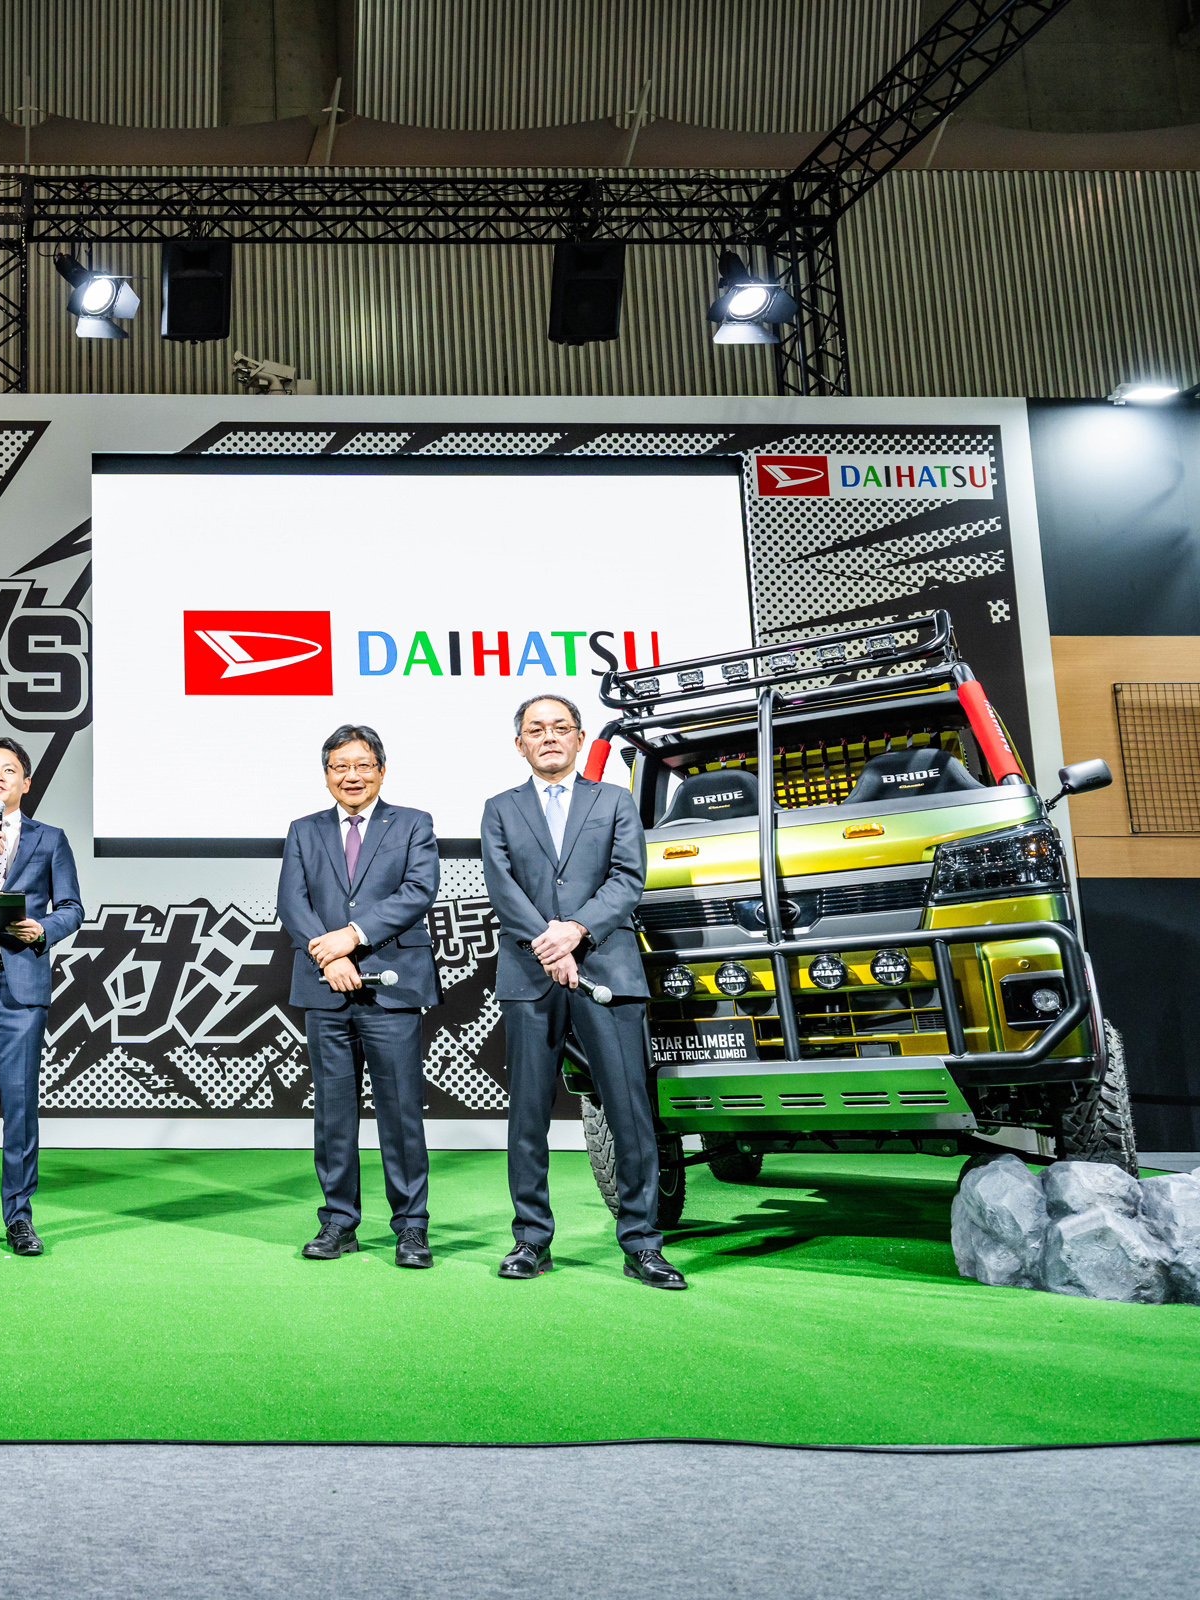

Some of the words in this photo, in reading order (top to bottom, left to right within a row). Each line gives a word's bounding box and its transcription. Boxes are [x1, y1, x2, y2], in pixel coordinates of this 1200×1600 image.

[840, 465, 987, 488] DAIHATSU
[358, 631, 661, 678] DAIHATSU
[881, 767, 941, 784] BRIDE
[692, 790, 744, 805] BRIDE
[812, 969, 841, 977] PIAA
[875, 965, 905, 973] PIAA
[664, 979, 690, 987] PIAA
[719, 976, 745, 984] PIAA
[650, 1036, 682, 1050] STAR
[685, 1033, 745, 1049] CLIMBER
[680, 1050, 711, 1060] TRUCK
[713, 1048, 748, 1059] JUMBO
